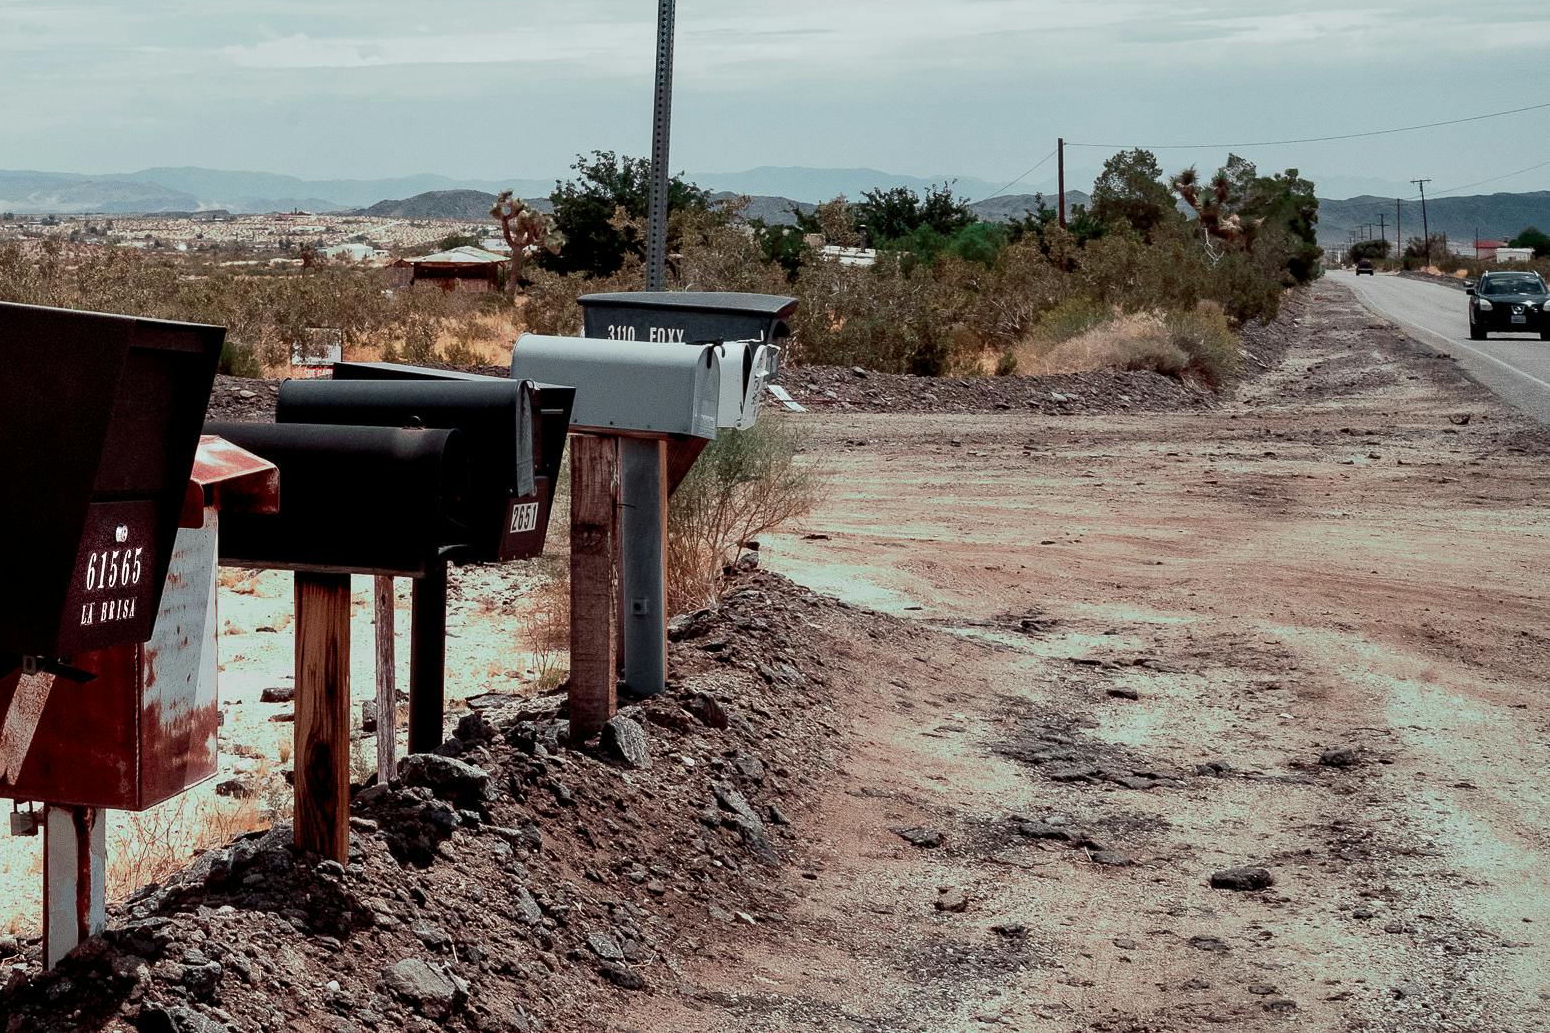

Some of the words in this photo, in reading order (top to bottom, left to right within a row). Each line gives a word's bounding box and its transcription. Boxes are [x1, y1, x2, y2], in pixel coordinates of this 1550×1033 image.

[607, 325, 636, 342] 3110
[650, 327, 685, 344] FOXY
[511, 505, 537, 531] 2651
[86, 547, 143, 591] 61565
[80, 602, 95, 626] LA
[101, 597, 138, 623] BRISA
